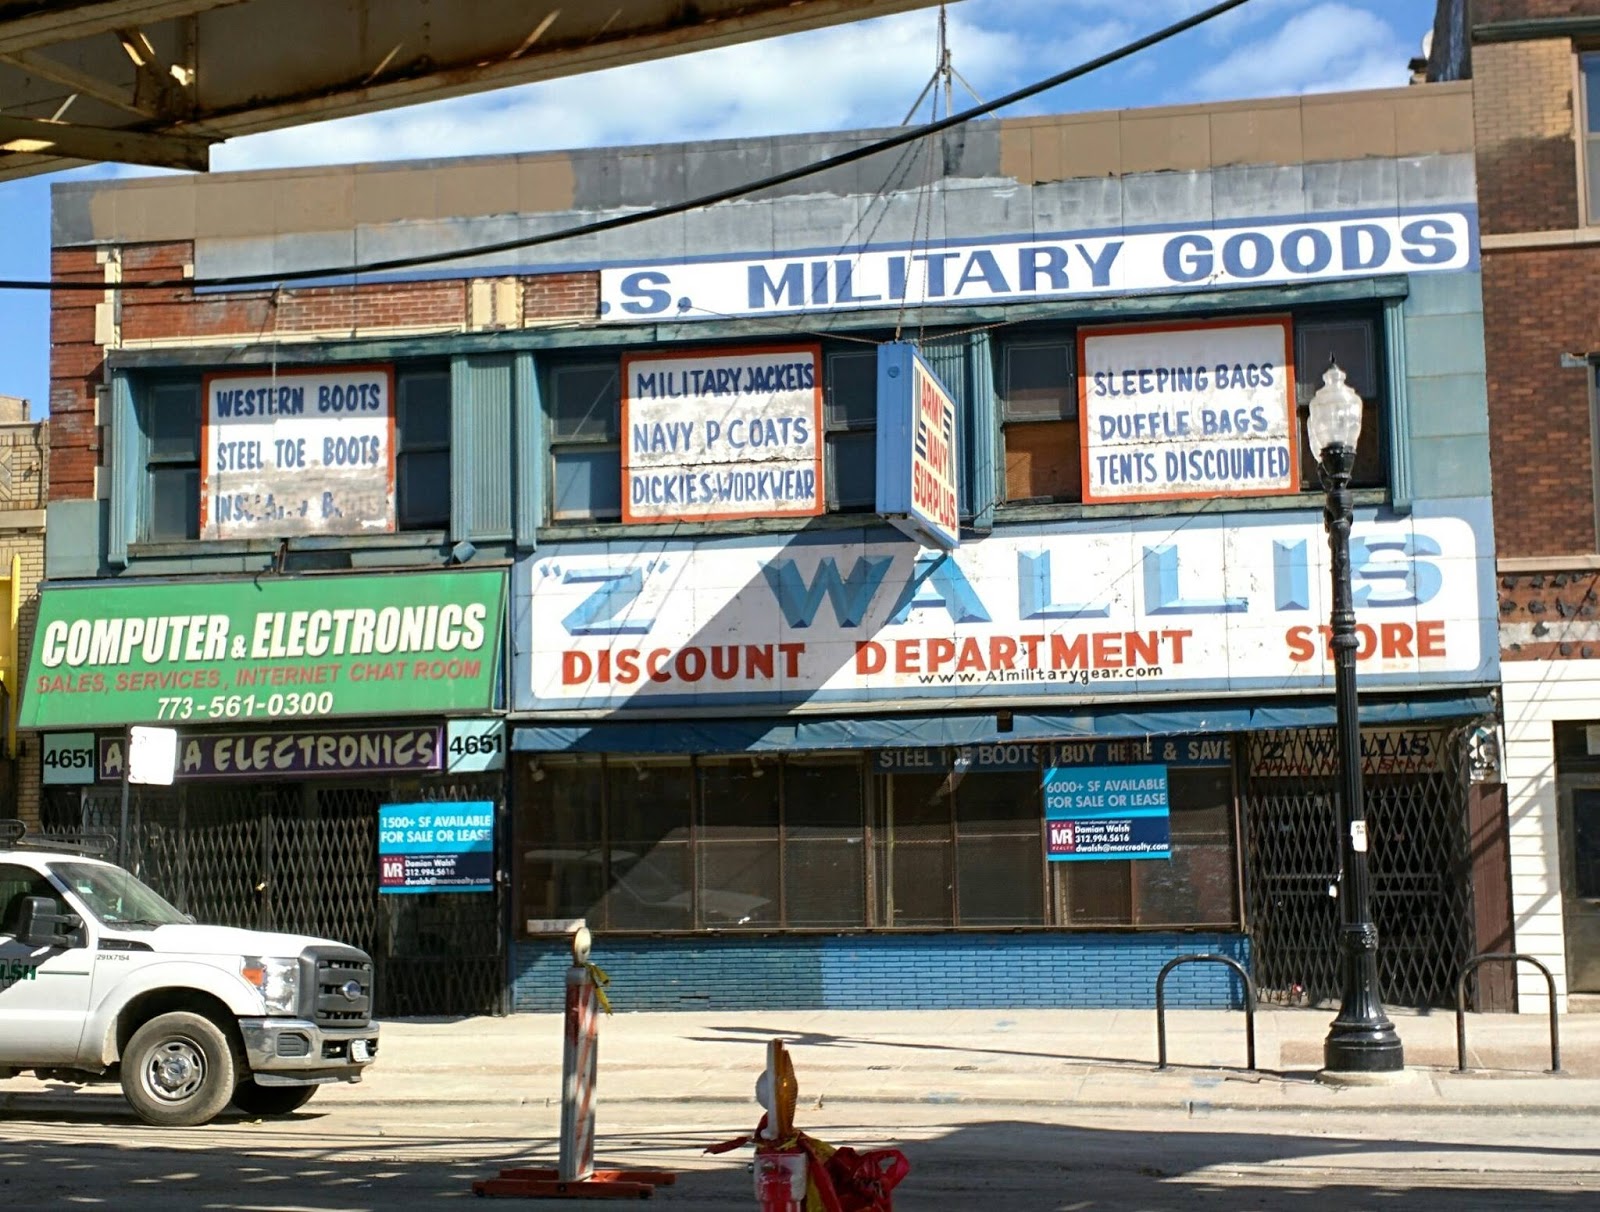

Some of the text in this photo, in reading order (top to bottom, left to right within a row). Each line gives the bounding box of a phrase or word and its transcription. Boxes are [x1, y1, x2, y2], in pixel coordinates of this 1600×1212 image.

[747, 242, 1124, 309] MILITARY
[1162, 219, 1457, 283] GOODS
[637, 362, 814, 400] MILITARY JACKETS
[1093, 362, 1275, 397] SLEEPING BAGS
[217, 383, 381, 418] WESTERN BOOTS
[921, 375, 943, 433] ARMY
[633, 417, 809, 454] NAVY P COATS
[1099, 406, 1268, 441] DUFFLE BAGS
[217, 435, 380, 471] STEEL TOE BOOTS
[926, 428, 948, 480] NAVY
[1096, 446, 1290, 486] TENTS DISCOUNTED
[914, 460, 957, 532] SURPLUS
[757, 533, 1443, 629] WALLIS
[41, 603, 487, 667] COMPUTER & ELECTRONICS
[562, 620, 1447, 686] DISCOUNT DEPARTMENT STORE
[36, 672, 109, 695] SALES,
[235, 662, 342, 687] INTERNET
[349, 661, 410, 682] CHAT
[413, 658, 482, 679] ROOM
[157, 691, 334, 720] 773-561-0300
[44, 750, 95, 769] 4651
[213, 731, 433, 771] ELECTRONICS
[448, 734, 503, 757] 4651
[879, 748, 934, 768] STEEL
[979, 745, 1040, 765] BOOTS
[1061, 740, 1231, 764] BUY HERE & SAVE
[1304, 736, 1430, 760] WLLIS
[1046, 778, 1166, 793] 6000+ SF AVAILABLE
[1047, 793, 1167, 809] FOR SALE OR LEASE
[381, 829, 491, 843] FOR SALE OR LEASE
[382, 815, 491, 829] 1500+ SF AVAILABLE
[1051, 828, 1073, 845] MR
[1105, 823, 1131, 833] Walsh
[383, 862, 403, 878] MR
